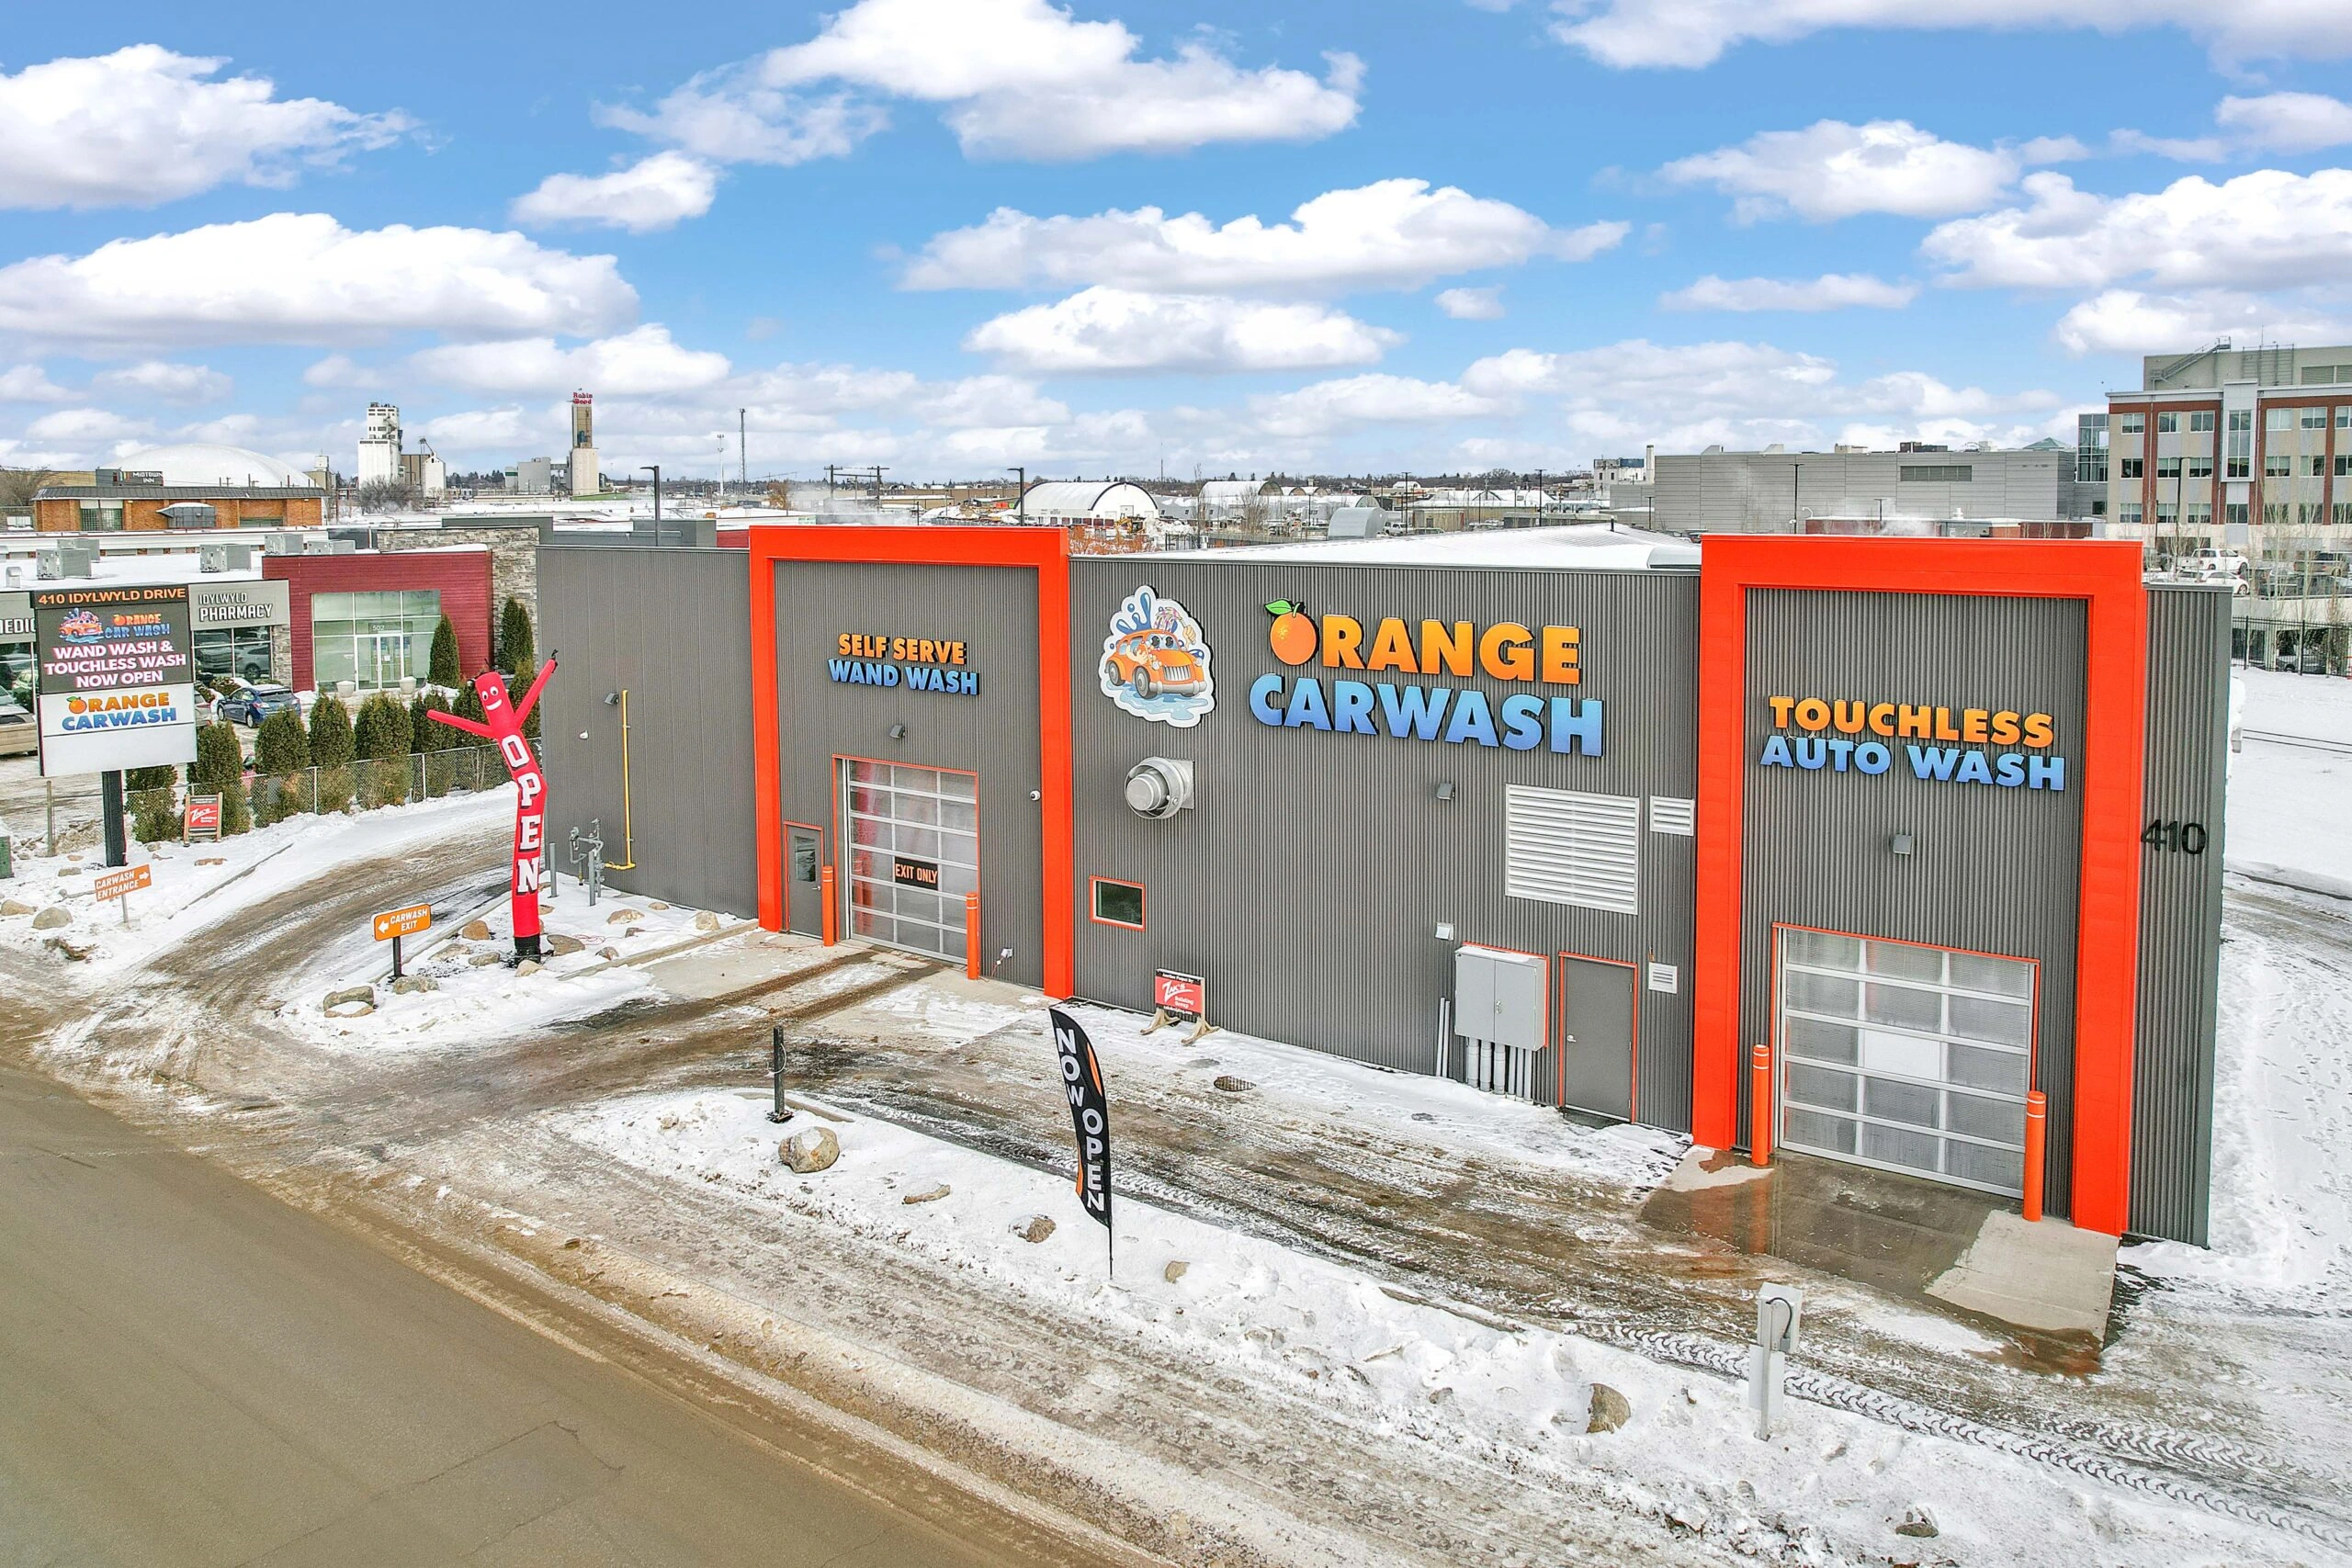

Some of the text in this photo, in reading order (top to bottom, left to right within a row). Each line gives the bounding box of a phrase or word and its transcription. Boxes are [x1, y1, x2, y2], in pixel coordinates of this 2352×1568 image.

[38, 588, 186, 604] 410 IDYLWYLD DRIVE
[198, 592, 248, 605] IDYLWYLD
[199, 604, 273, 622] PHARMACY
[105, 623, 170, 639] CAR WASH
[53, 639, 175, 660] WAND WASH &
[838, 634, 967, 665] SELF SERVE
[44, 653, 187, 675] TOUCHLESS WASH
[75, 670, 164, 688] NOW OPEN
[828, 659, 980, 695] WAND WASH
[62, 707, 176, 731] CARWASH
[1249, 672, 1603, 757] CARWASH
[1769, 695, 2054, 749] TOUCHLESS
[1759, 735, 2066, 792] AUTO WASH
[502, 734, 542, 894] OPEN
[2141, 818, 2206, 854] 410
[96, 871, 135, 889] CARWASH
[895, 863, 938, 884] EXIT ONLY
[97, 879, 140, 899] ENTRANCE
[390, 908, 428, 925] CARWASH
[401, 919, 418, 931] EXIT
[1056, 1027, 1105, 1212] NOW OPEN
